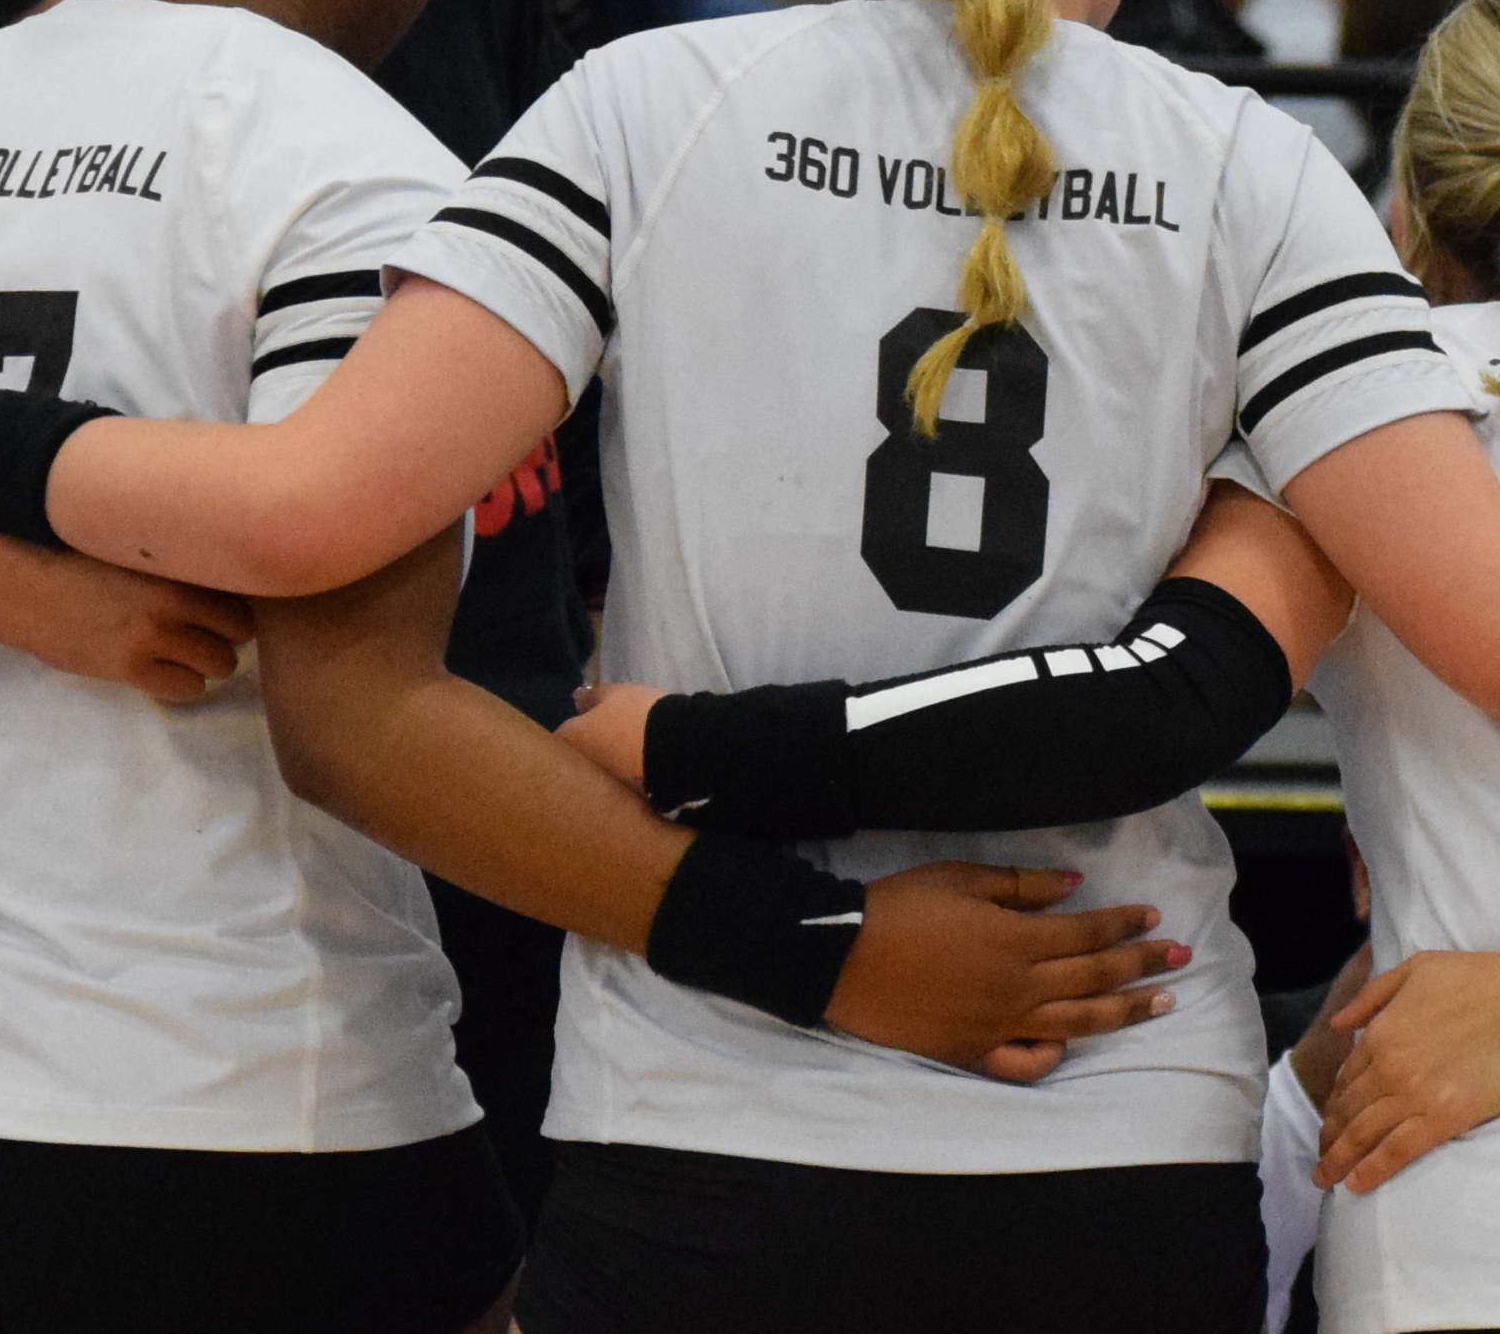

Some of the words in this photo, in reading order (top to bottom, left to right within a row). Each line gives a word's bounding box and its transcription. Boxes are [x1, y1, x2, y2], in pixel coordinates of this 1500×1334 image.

[764, 131, 859, 199] 360
[878, 154, 1180, 233] VOLBALL
[860, 307, 1051, 620] 8
